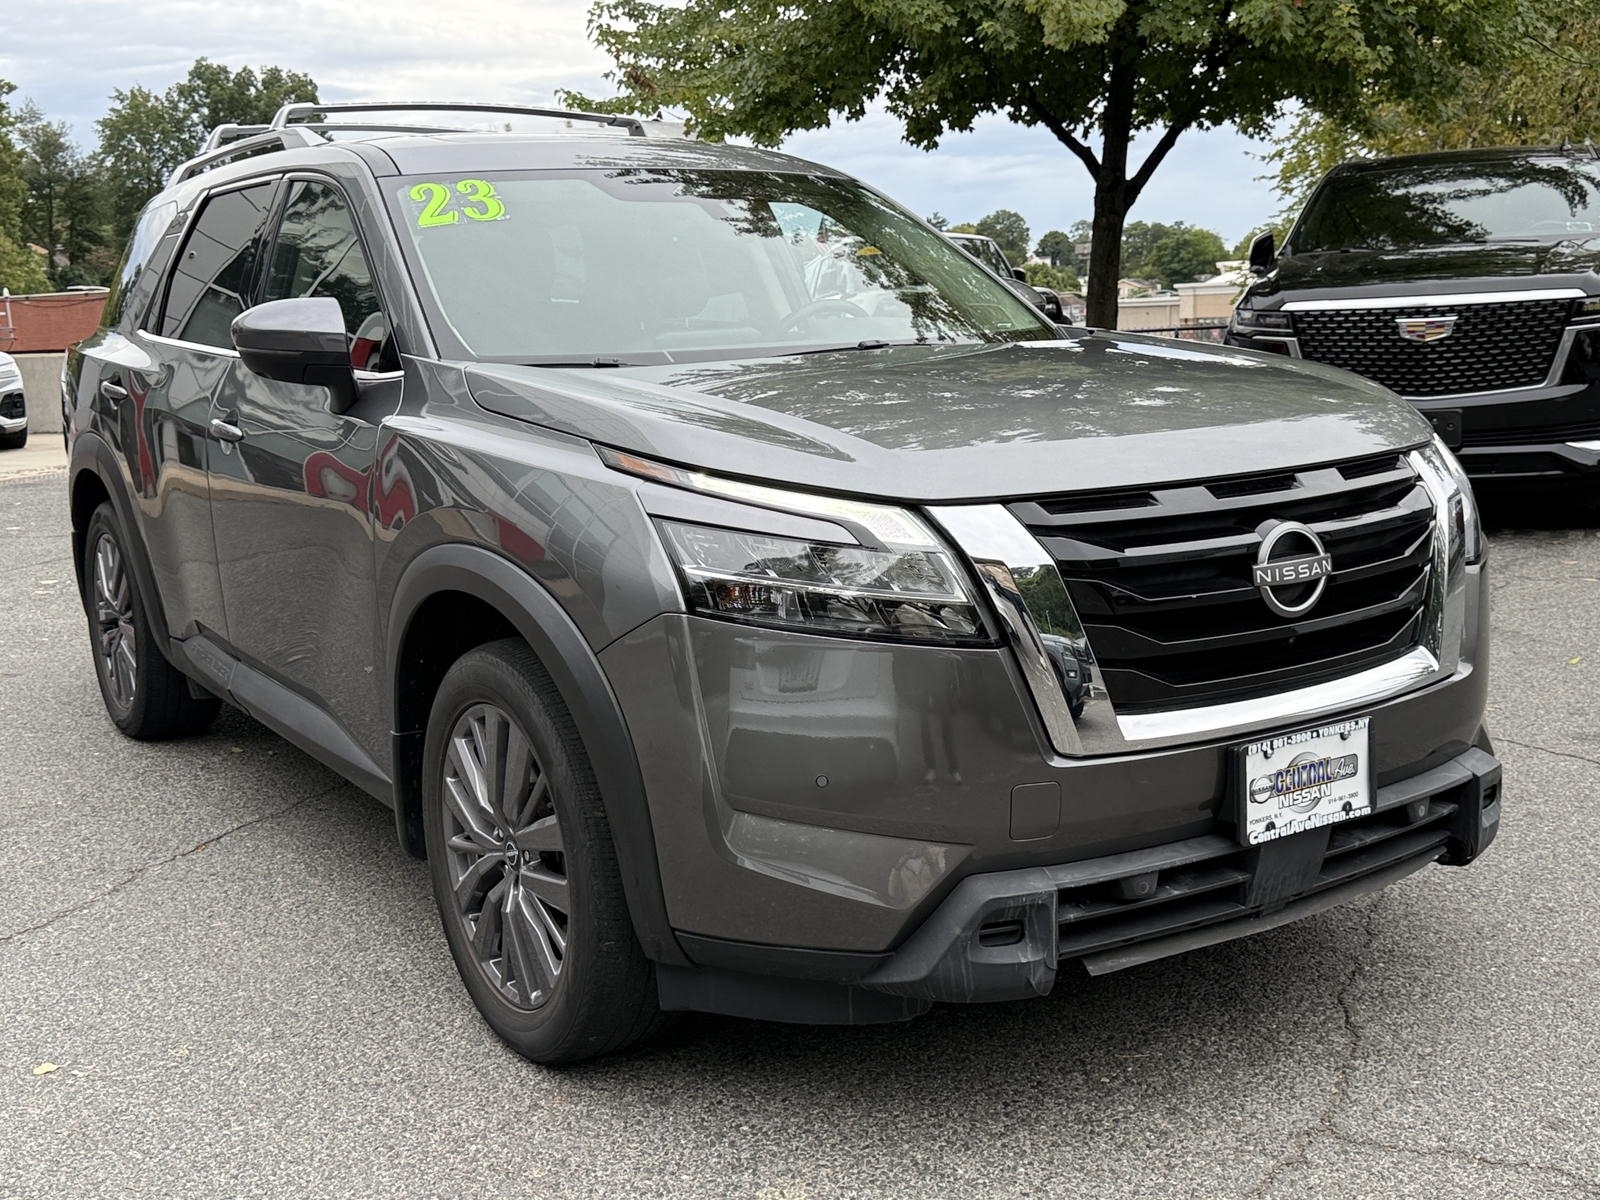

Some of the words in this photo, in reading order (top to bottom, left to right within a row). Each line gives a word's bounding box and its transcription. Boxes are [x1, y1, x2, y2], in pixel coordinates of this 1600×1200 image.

[409, 179, 505, 228] 23
[1256, 558, 1332, 583] NISSAN
[1275, 757, 1333, 795] CENTRAL
[1278, 784, 1332, 810] NISSAN
[1248, 806, 1372, 845] CentralAveNissan.com
